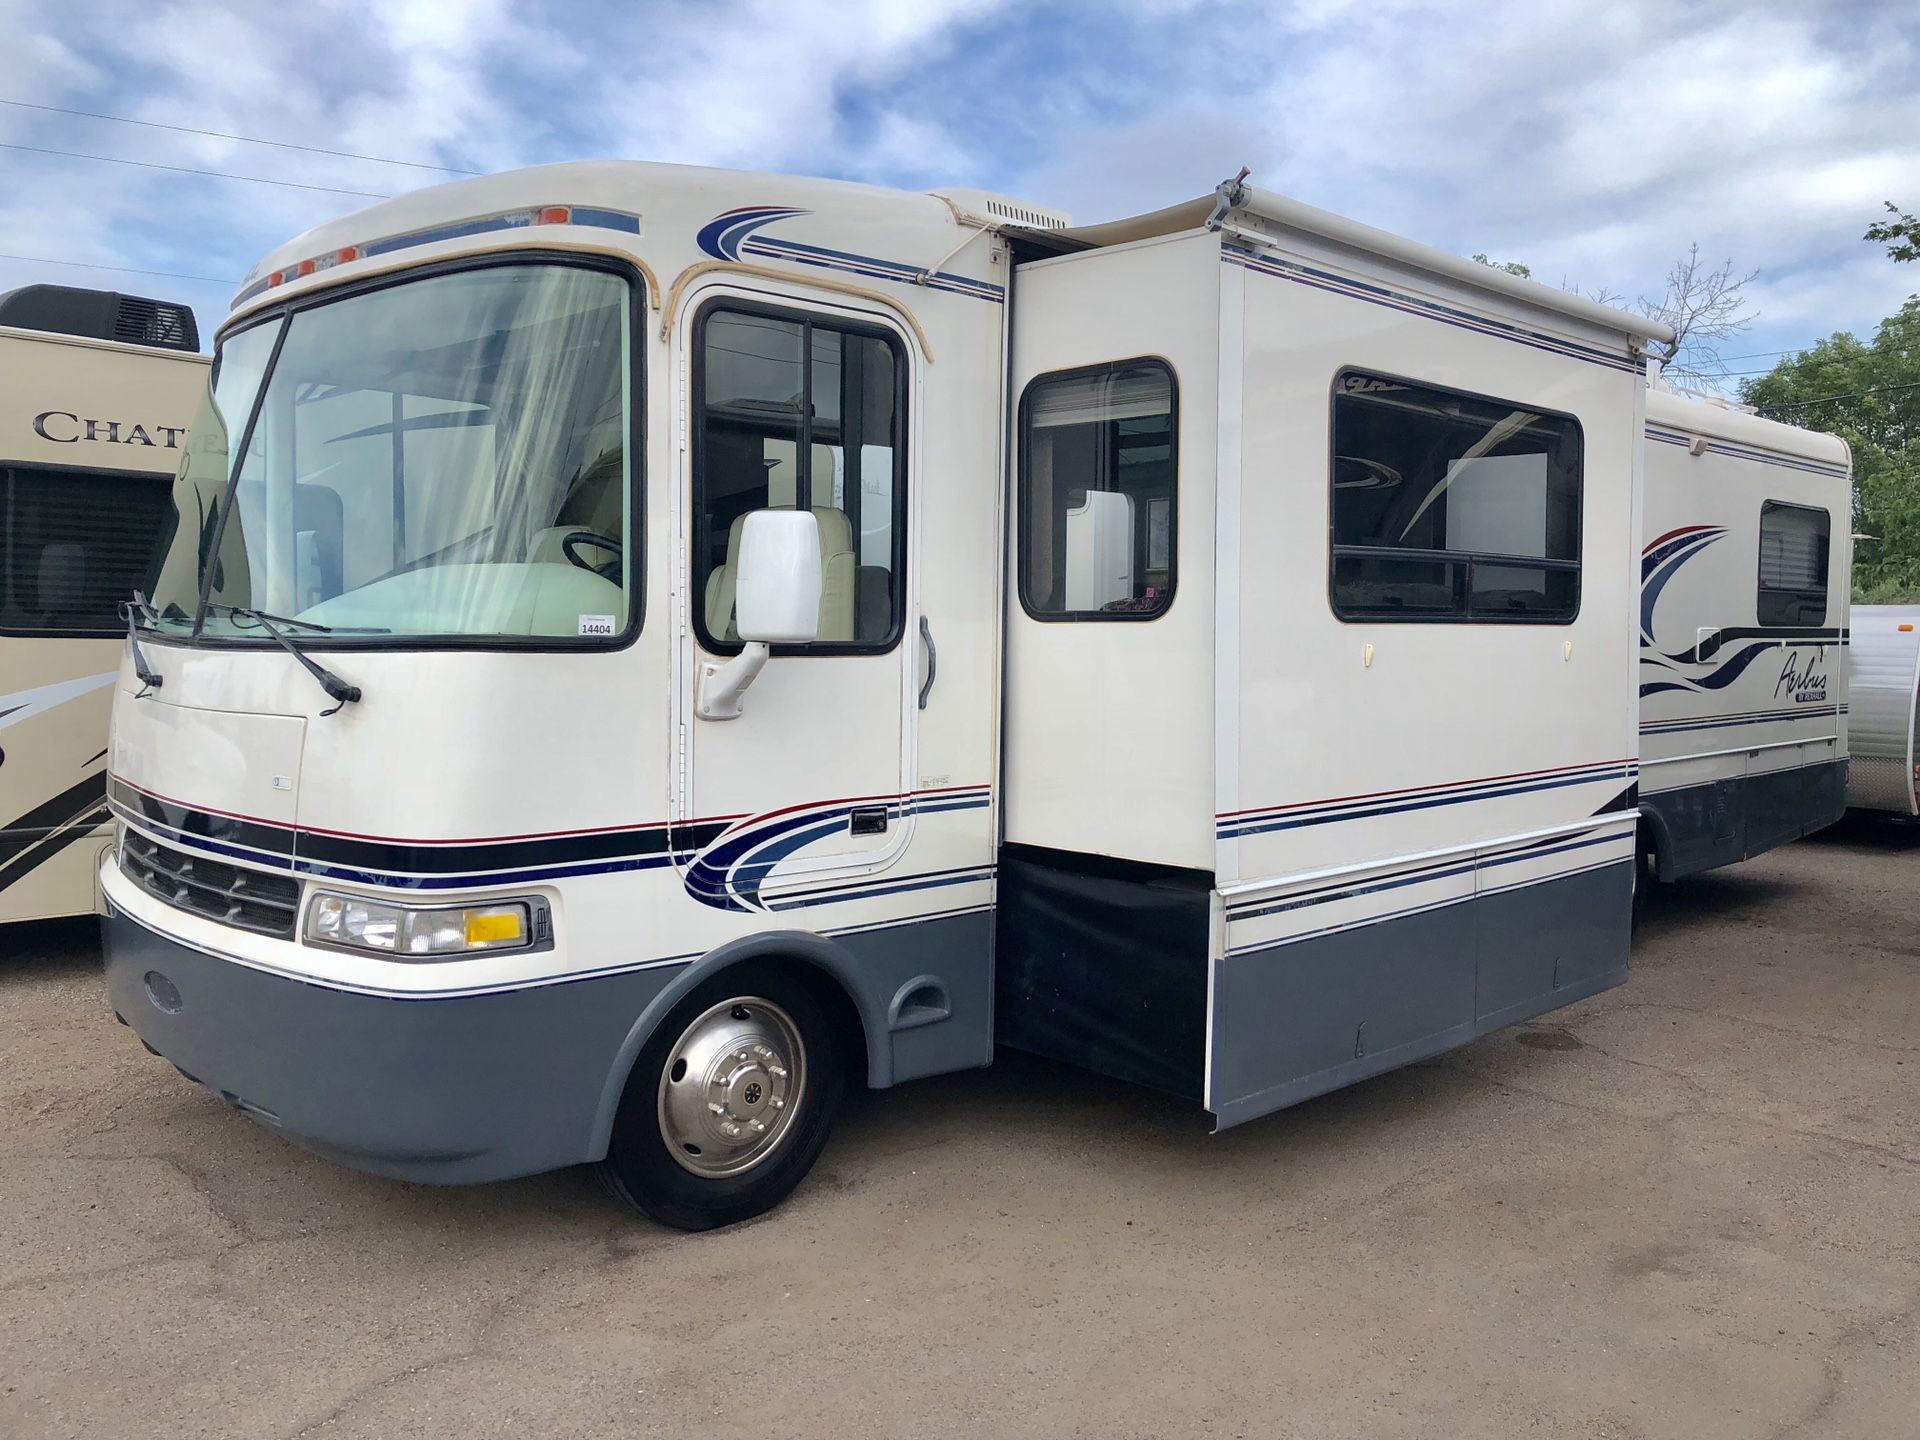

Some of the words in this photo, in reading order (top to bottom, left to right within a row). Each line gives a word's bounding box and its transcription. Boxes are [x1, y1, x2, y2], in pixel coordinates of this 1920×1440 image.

[32, 410, 189, 449] CHAT
[582, 624, 611, 634] 14404
[1773, 650, 1827, 700] Aerbus
